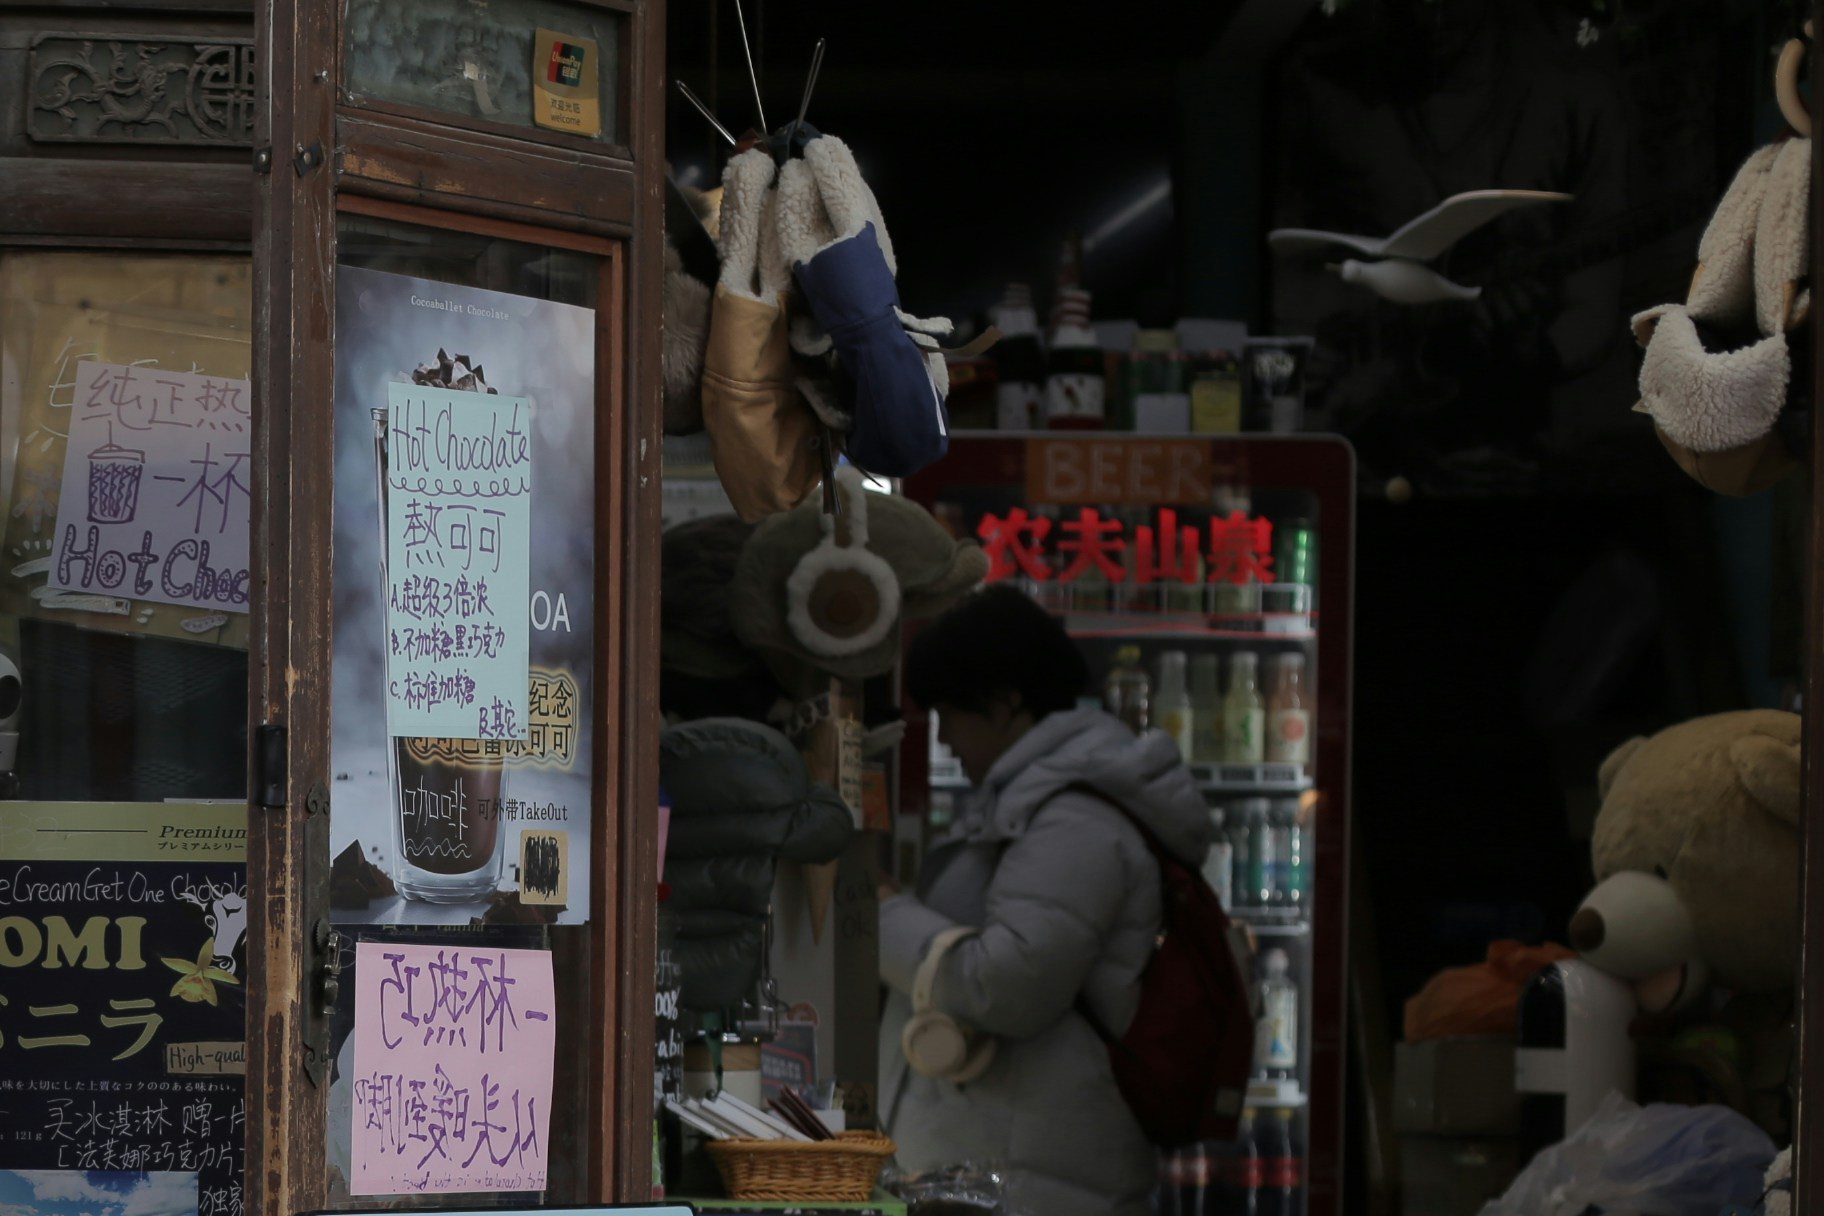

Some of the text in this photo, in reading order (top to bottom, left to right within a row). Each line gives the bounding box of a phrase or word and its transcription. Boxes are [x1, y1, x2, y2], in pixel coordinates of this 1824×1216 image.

[551, 113, 581, 126] welcome
[410, 294, 509, 321] Cocoaballet Chocolate
[392, 399, 530, 475] Hot Chocolate
[153, 442, 250, 534] 一杯
[1044, 442, 1212, 499] BEER
[57, 523, 160, 596] Hot
[977, 505, 1277, 585] 农夫山泉
[12, 864, 86, 904] Cream
[84, 866, 124, 903] Get
[128, 871, 165, 904] One
